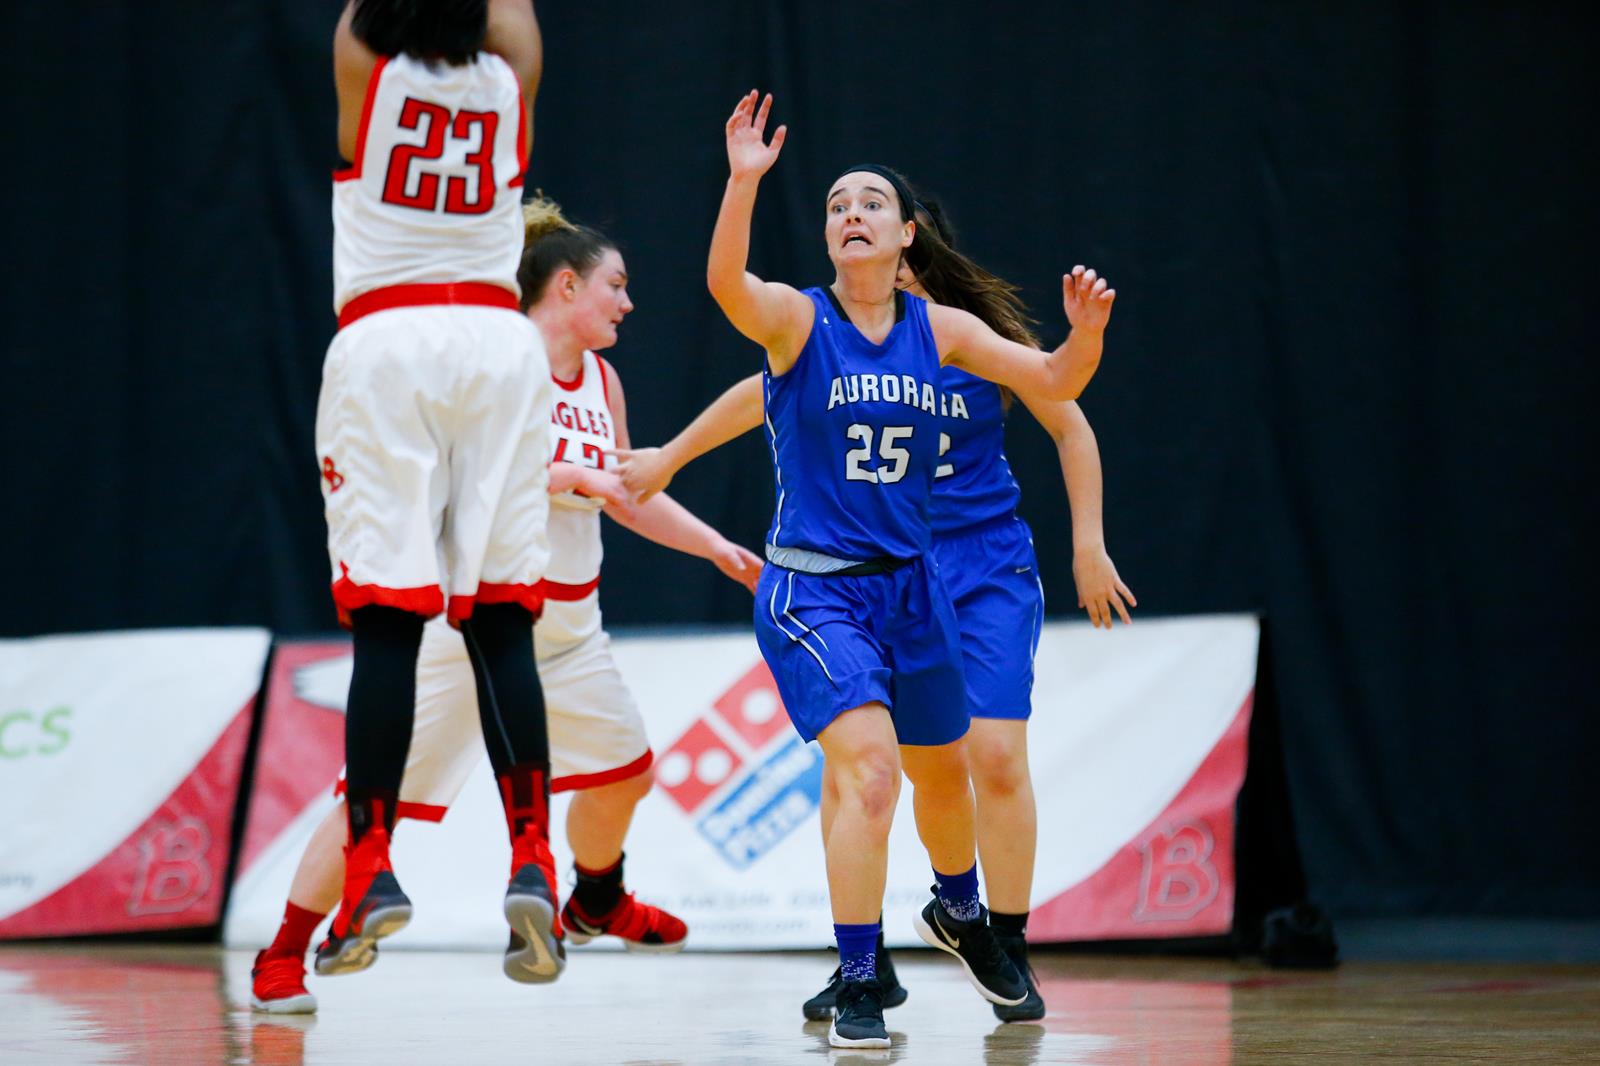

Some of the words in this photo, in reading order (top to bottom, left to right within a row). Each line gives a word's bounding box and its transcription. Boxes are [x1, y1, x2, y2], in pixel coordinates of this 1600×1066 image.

[381, 96, 499, 215] 23
[827, 373, 936, 417] AURORA
[845, 423, 914, 484] 25
[1131, 817, 1220, 923] B
